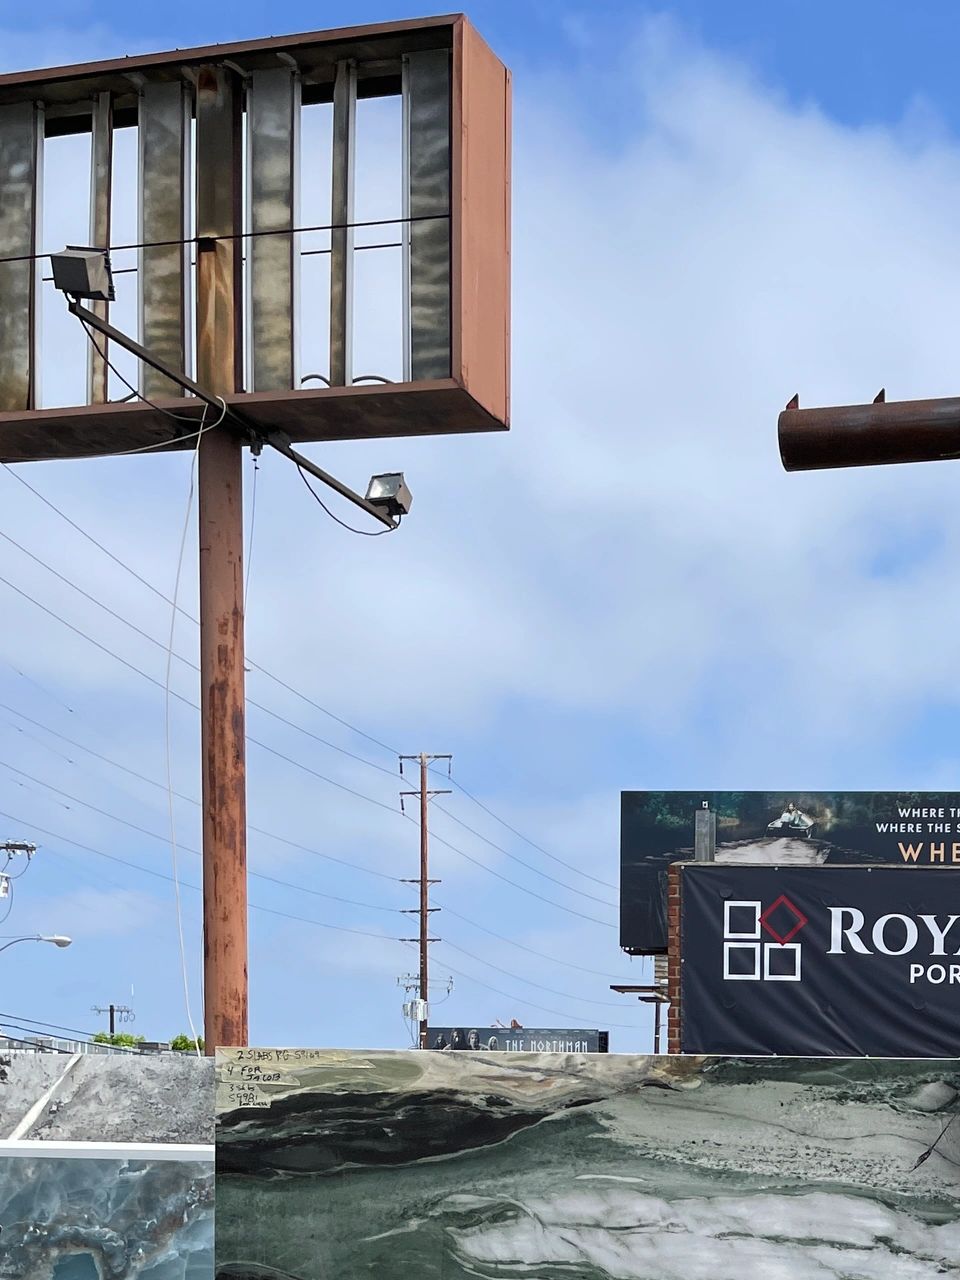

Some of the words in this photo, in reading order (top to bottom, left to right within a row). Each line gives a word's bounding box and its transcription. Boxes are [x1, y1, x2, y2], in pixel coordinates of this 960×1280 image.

[898, 807, 945, 818] WHERE
[876, 823, 923, 833] WHERE
[927, 823, 951, 833] THE
[505, 1040, 524, 1052] THE
[530, 1040, 588, 1053] NORTHMAN
[241, 1066, 262, 1076] FOR
